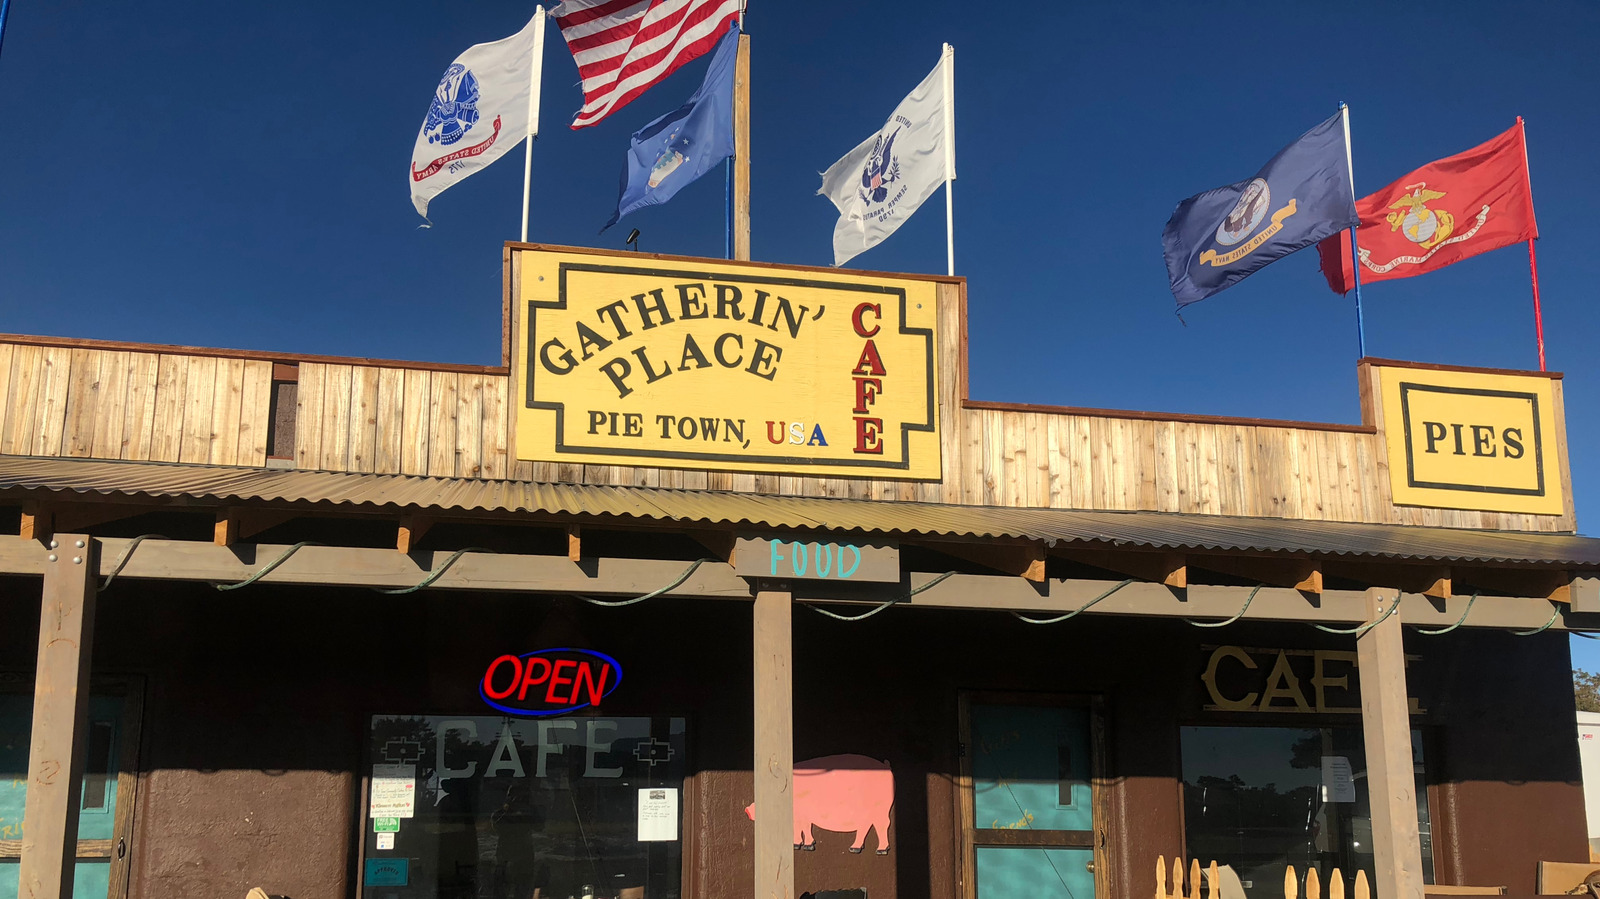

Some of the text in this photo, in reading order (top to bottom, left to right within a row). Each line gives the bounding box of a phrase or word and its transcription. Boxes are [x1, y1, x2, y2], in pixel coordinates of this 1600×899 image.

[539, 283, 825, 376] GATHERIN'
[599, 332, 783, 399] PLACE
[851, 302, 886, 455] CAFE
[587, 410, 829, 449] PIE TOWN, USA
[1422, 421, 1525, 459] PIES
[770, 538, 861, 578] FOOD
[483, 654, 610, 706] OPEN
[1201, 645, 1420, 714] CAF
[435, 720, 624, 779] CAFE
